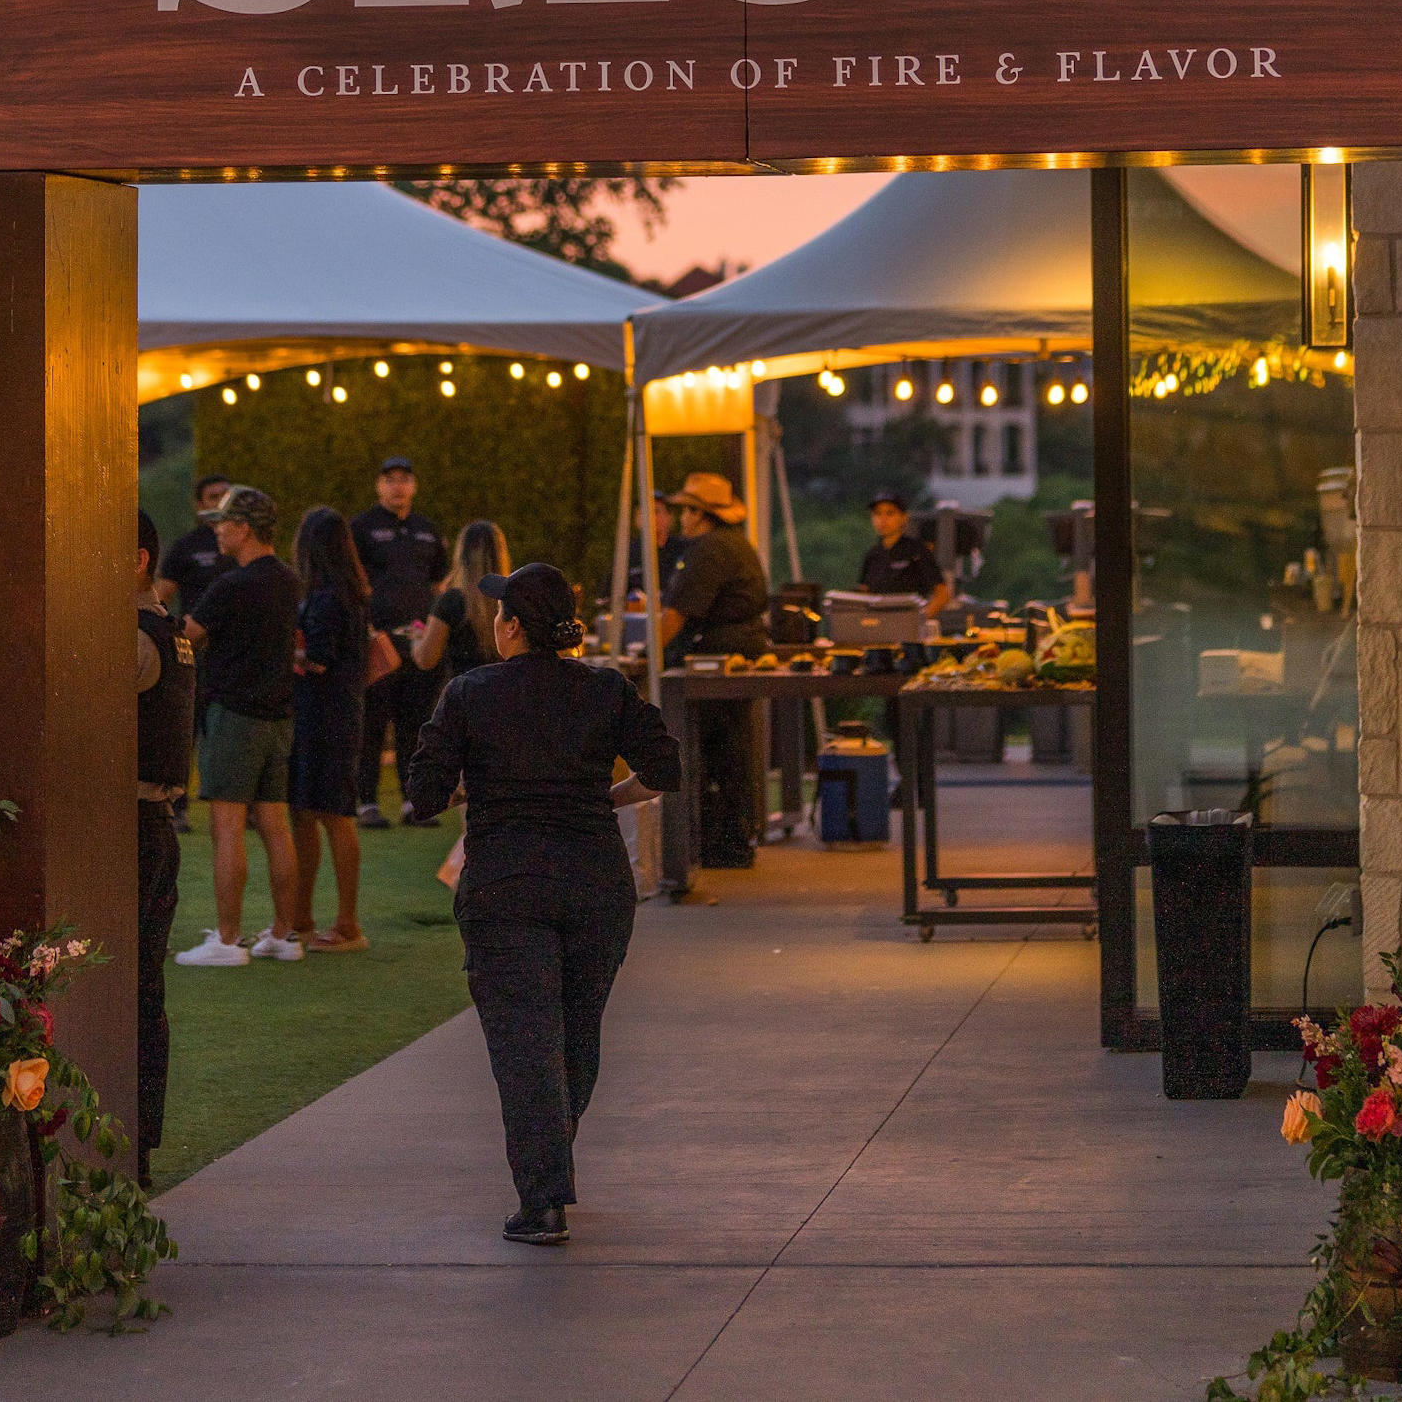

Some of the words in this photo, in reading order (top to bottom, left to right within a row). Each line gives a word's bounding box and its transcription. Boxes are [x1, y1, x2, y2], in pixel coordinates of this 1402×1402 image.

[234, 66, 265, 97] A
[297, 60, 696, 97] CELEBRATION
[730, 58, 798, 90] OF
[833, 55, 961, 87] FIRE
[995, 52, 1024, 85] &
[1057, 47, 1282, 83] FLAVOR
